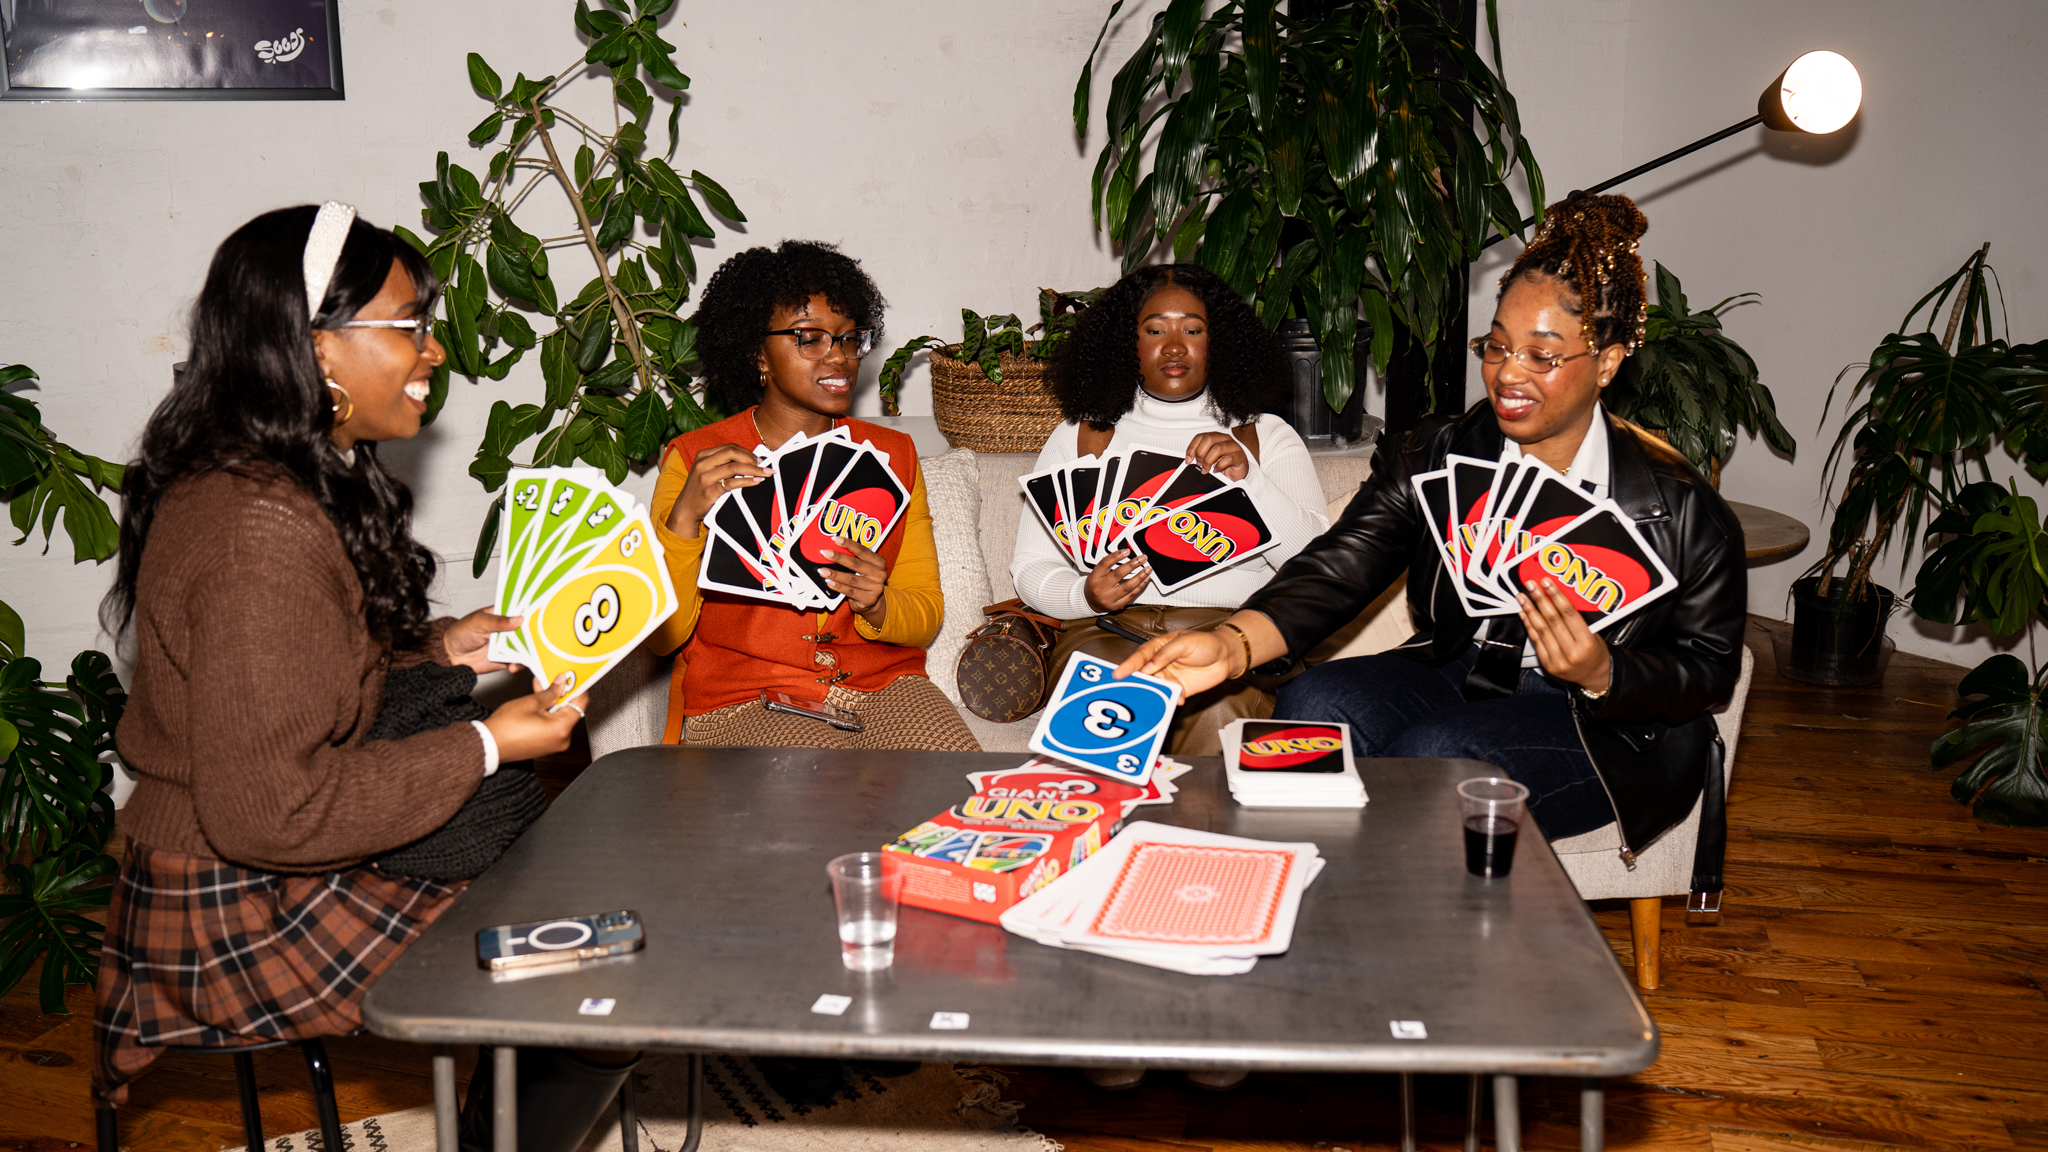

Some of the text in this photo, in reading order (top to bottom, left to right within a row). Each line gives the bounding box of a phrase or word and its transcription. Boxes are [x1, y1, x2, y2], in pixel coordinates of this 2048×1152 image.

[515, 483, 539, 511] +2
[818, 498, 882, 549] UNO
[1168, 509, 1236, 565] UNO
[620, 528, 643, 558] 8
[1538, 542, 1626, 616] UNO
[573, 583, 621, 647] 8
[1080, 664, 1102, 683] 3
[1083, 699, 1136, 739] 3
[1241, 736, 1343, 757] UNO
[1116, 753, 1142, 773] 3
[987, 787, 1076, 800] GIANT
[950, 796, 1105, 822] UNO
